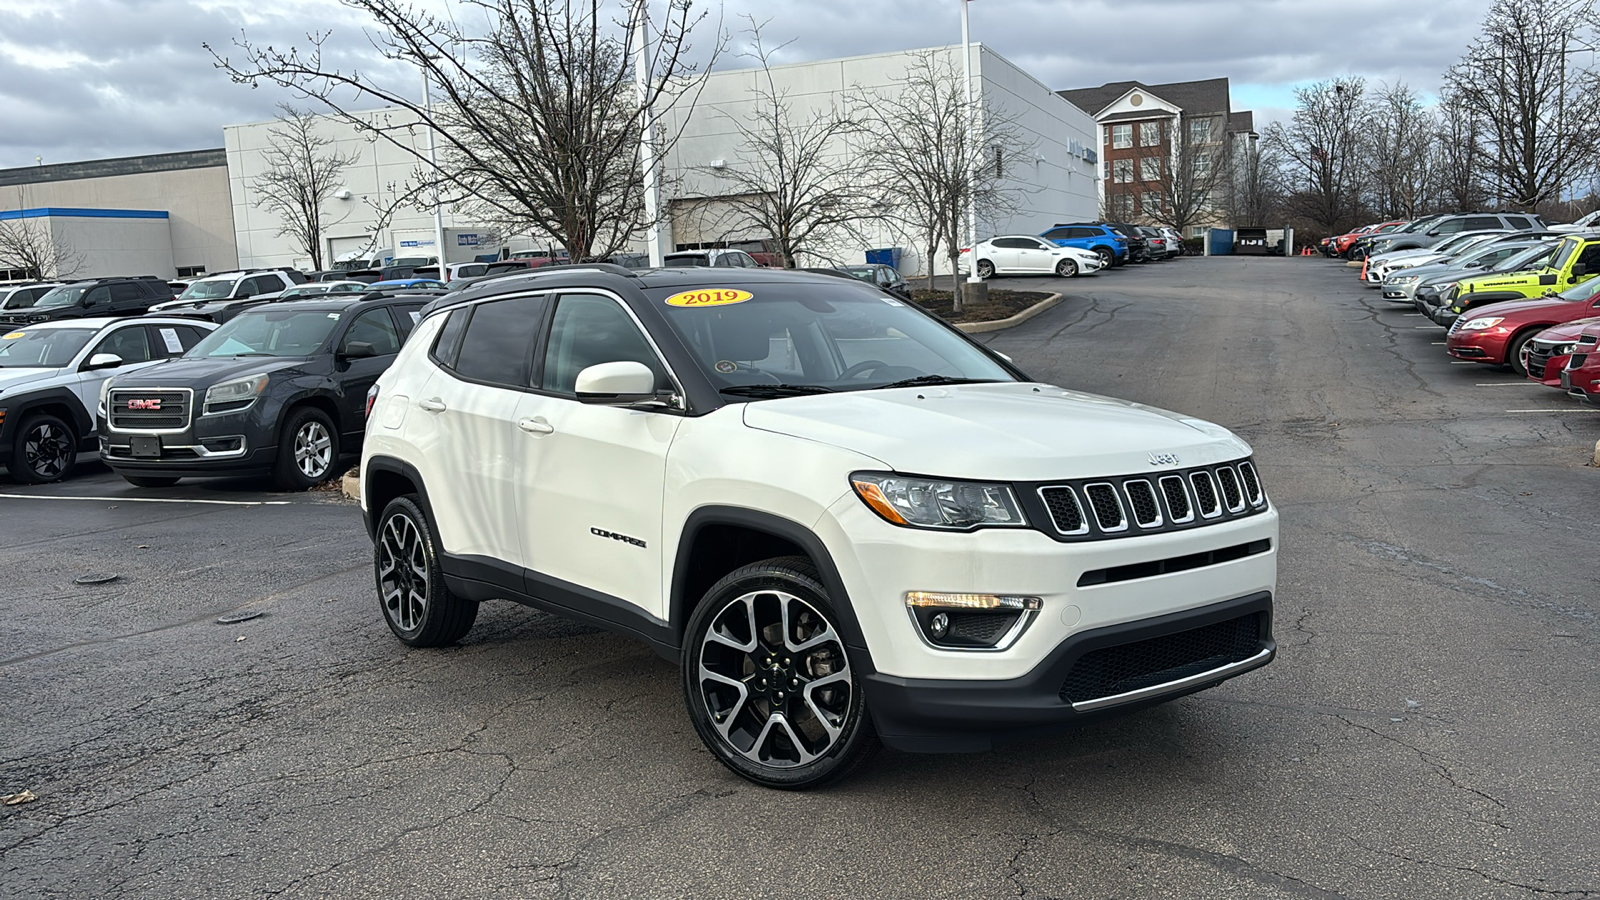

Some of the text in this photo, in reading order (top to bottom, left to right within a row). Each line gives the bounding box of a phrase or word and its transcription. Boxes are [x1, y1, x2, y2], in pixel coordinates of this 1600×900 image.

[683, 290, 739, 305] 2019
[128, 399, 161, 410] GMC
[1147, 451, 1180, 466] Jeep
[590, 526, 648, 549] COMPASS
